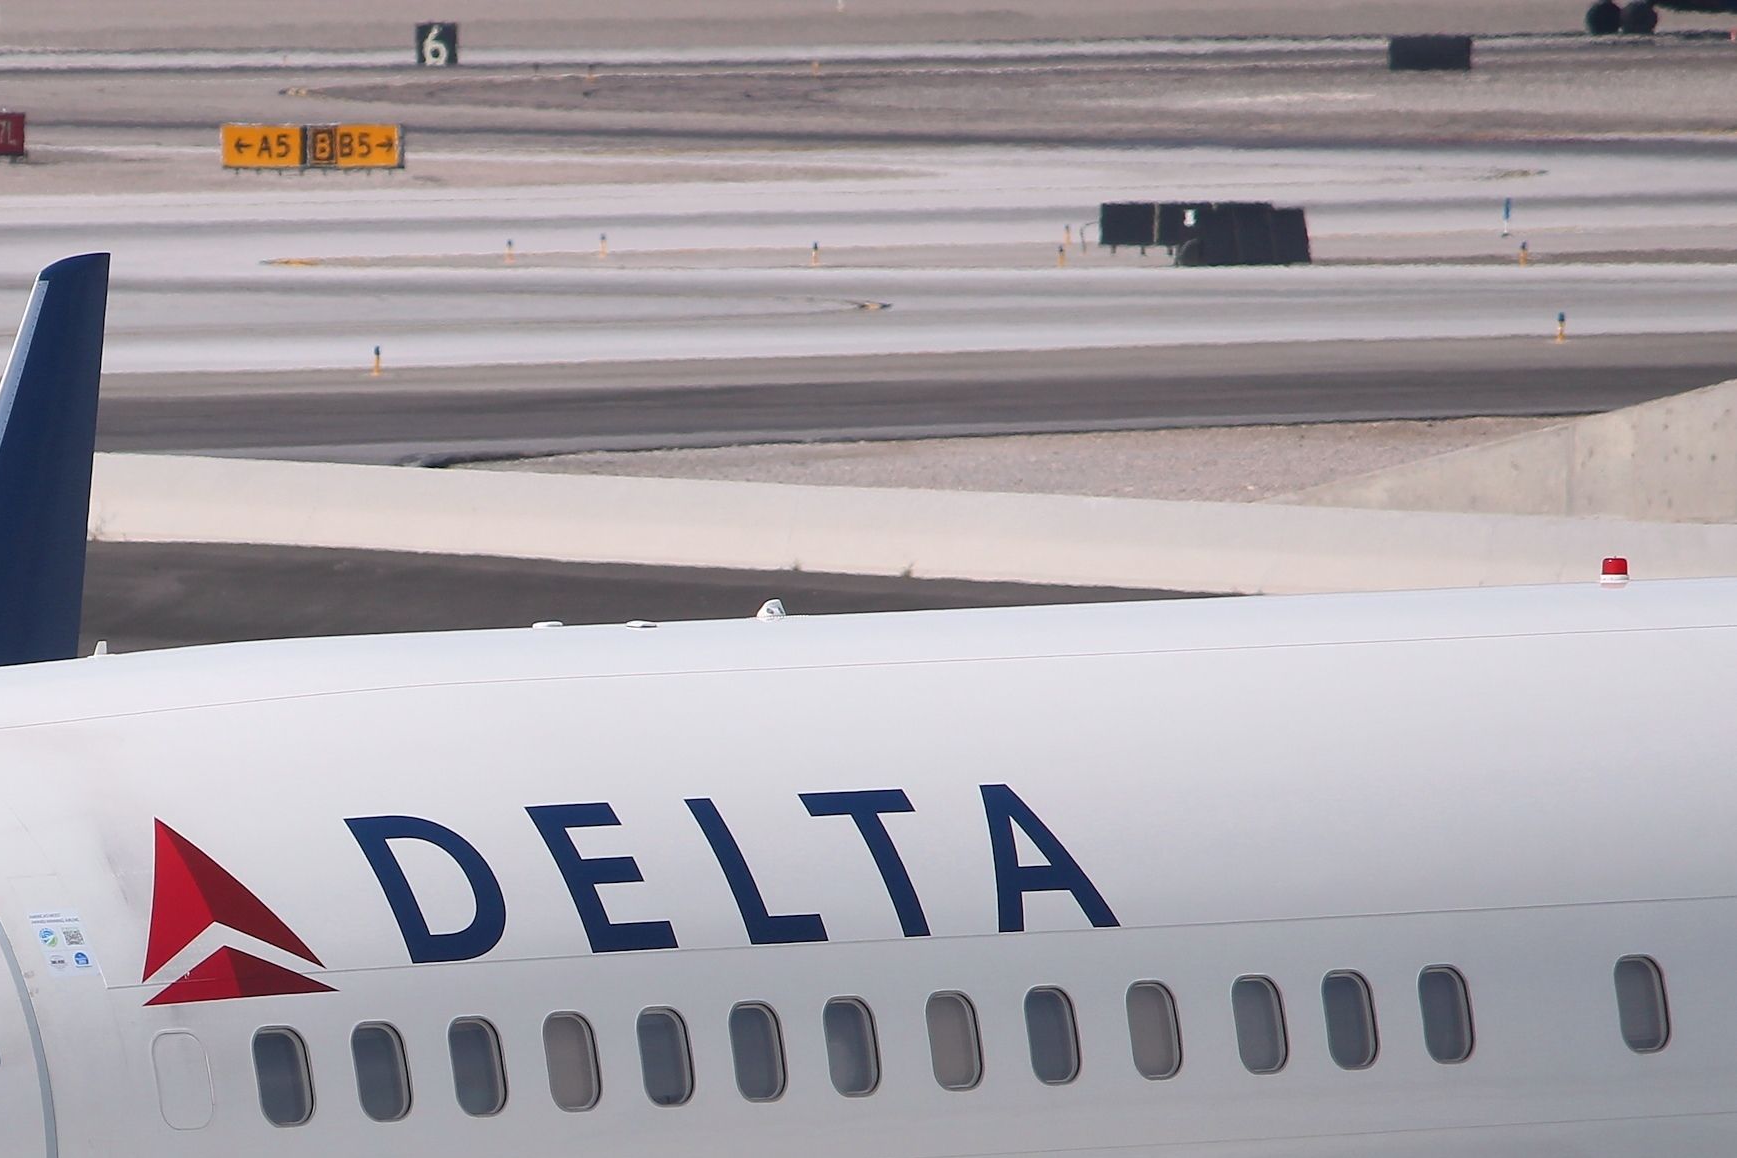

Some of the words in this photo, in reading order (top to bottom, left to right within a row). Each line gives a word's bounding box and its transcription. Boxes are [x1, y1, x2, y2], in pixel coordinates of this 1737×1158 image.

[423, 25, 447, 66] 6
[257, 133, 291, 158] A5
[315, 131, 331, 161] B
[339, 132, 371, 158] B5
[344, 784, 1120, 963] DELTA
